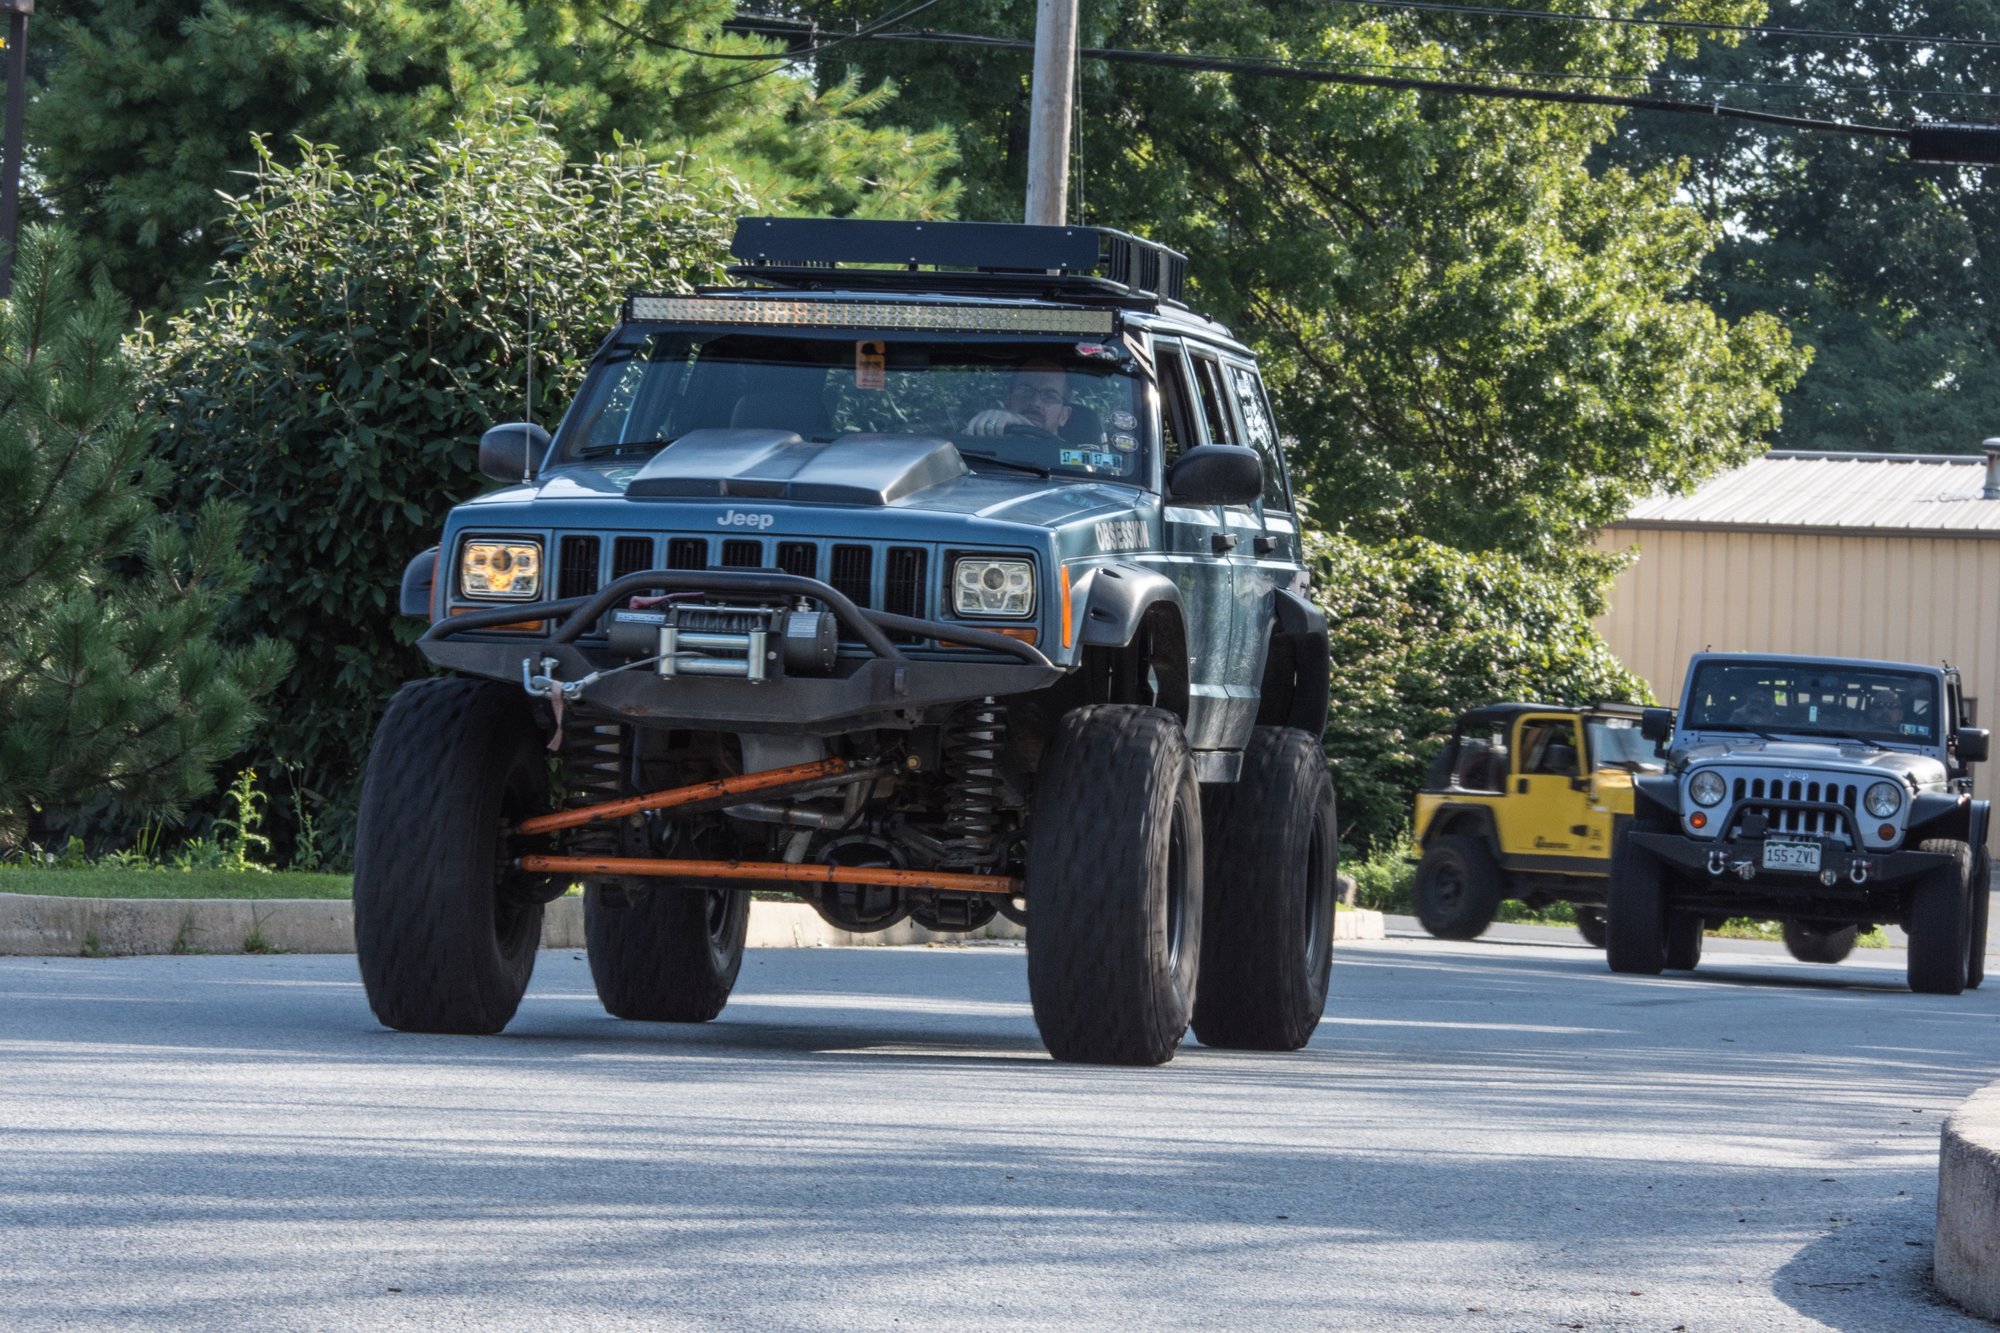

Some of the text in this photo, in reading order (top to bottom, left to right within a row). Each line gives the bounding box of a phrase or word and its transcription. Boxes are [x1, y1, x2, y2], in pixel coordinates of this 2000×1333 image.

[716, 509, 775, 530] Jeep
[1095, 520, 1150, 551] OBSESSION
[1784, 769, 1809, 781] Jeep
[1767, 848, 1817, 865] 155-ZVL
